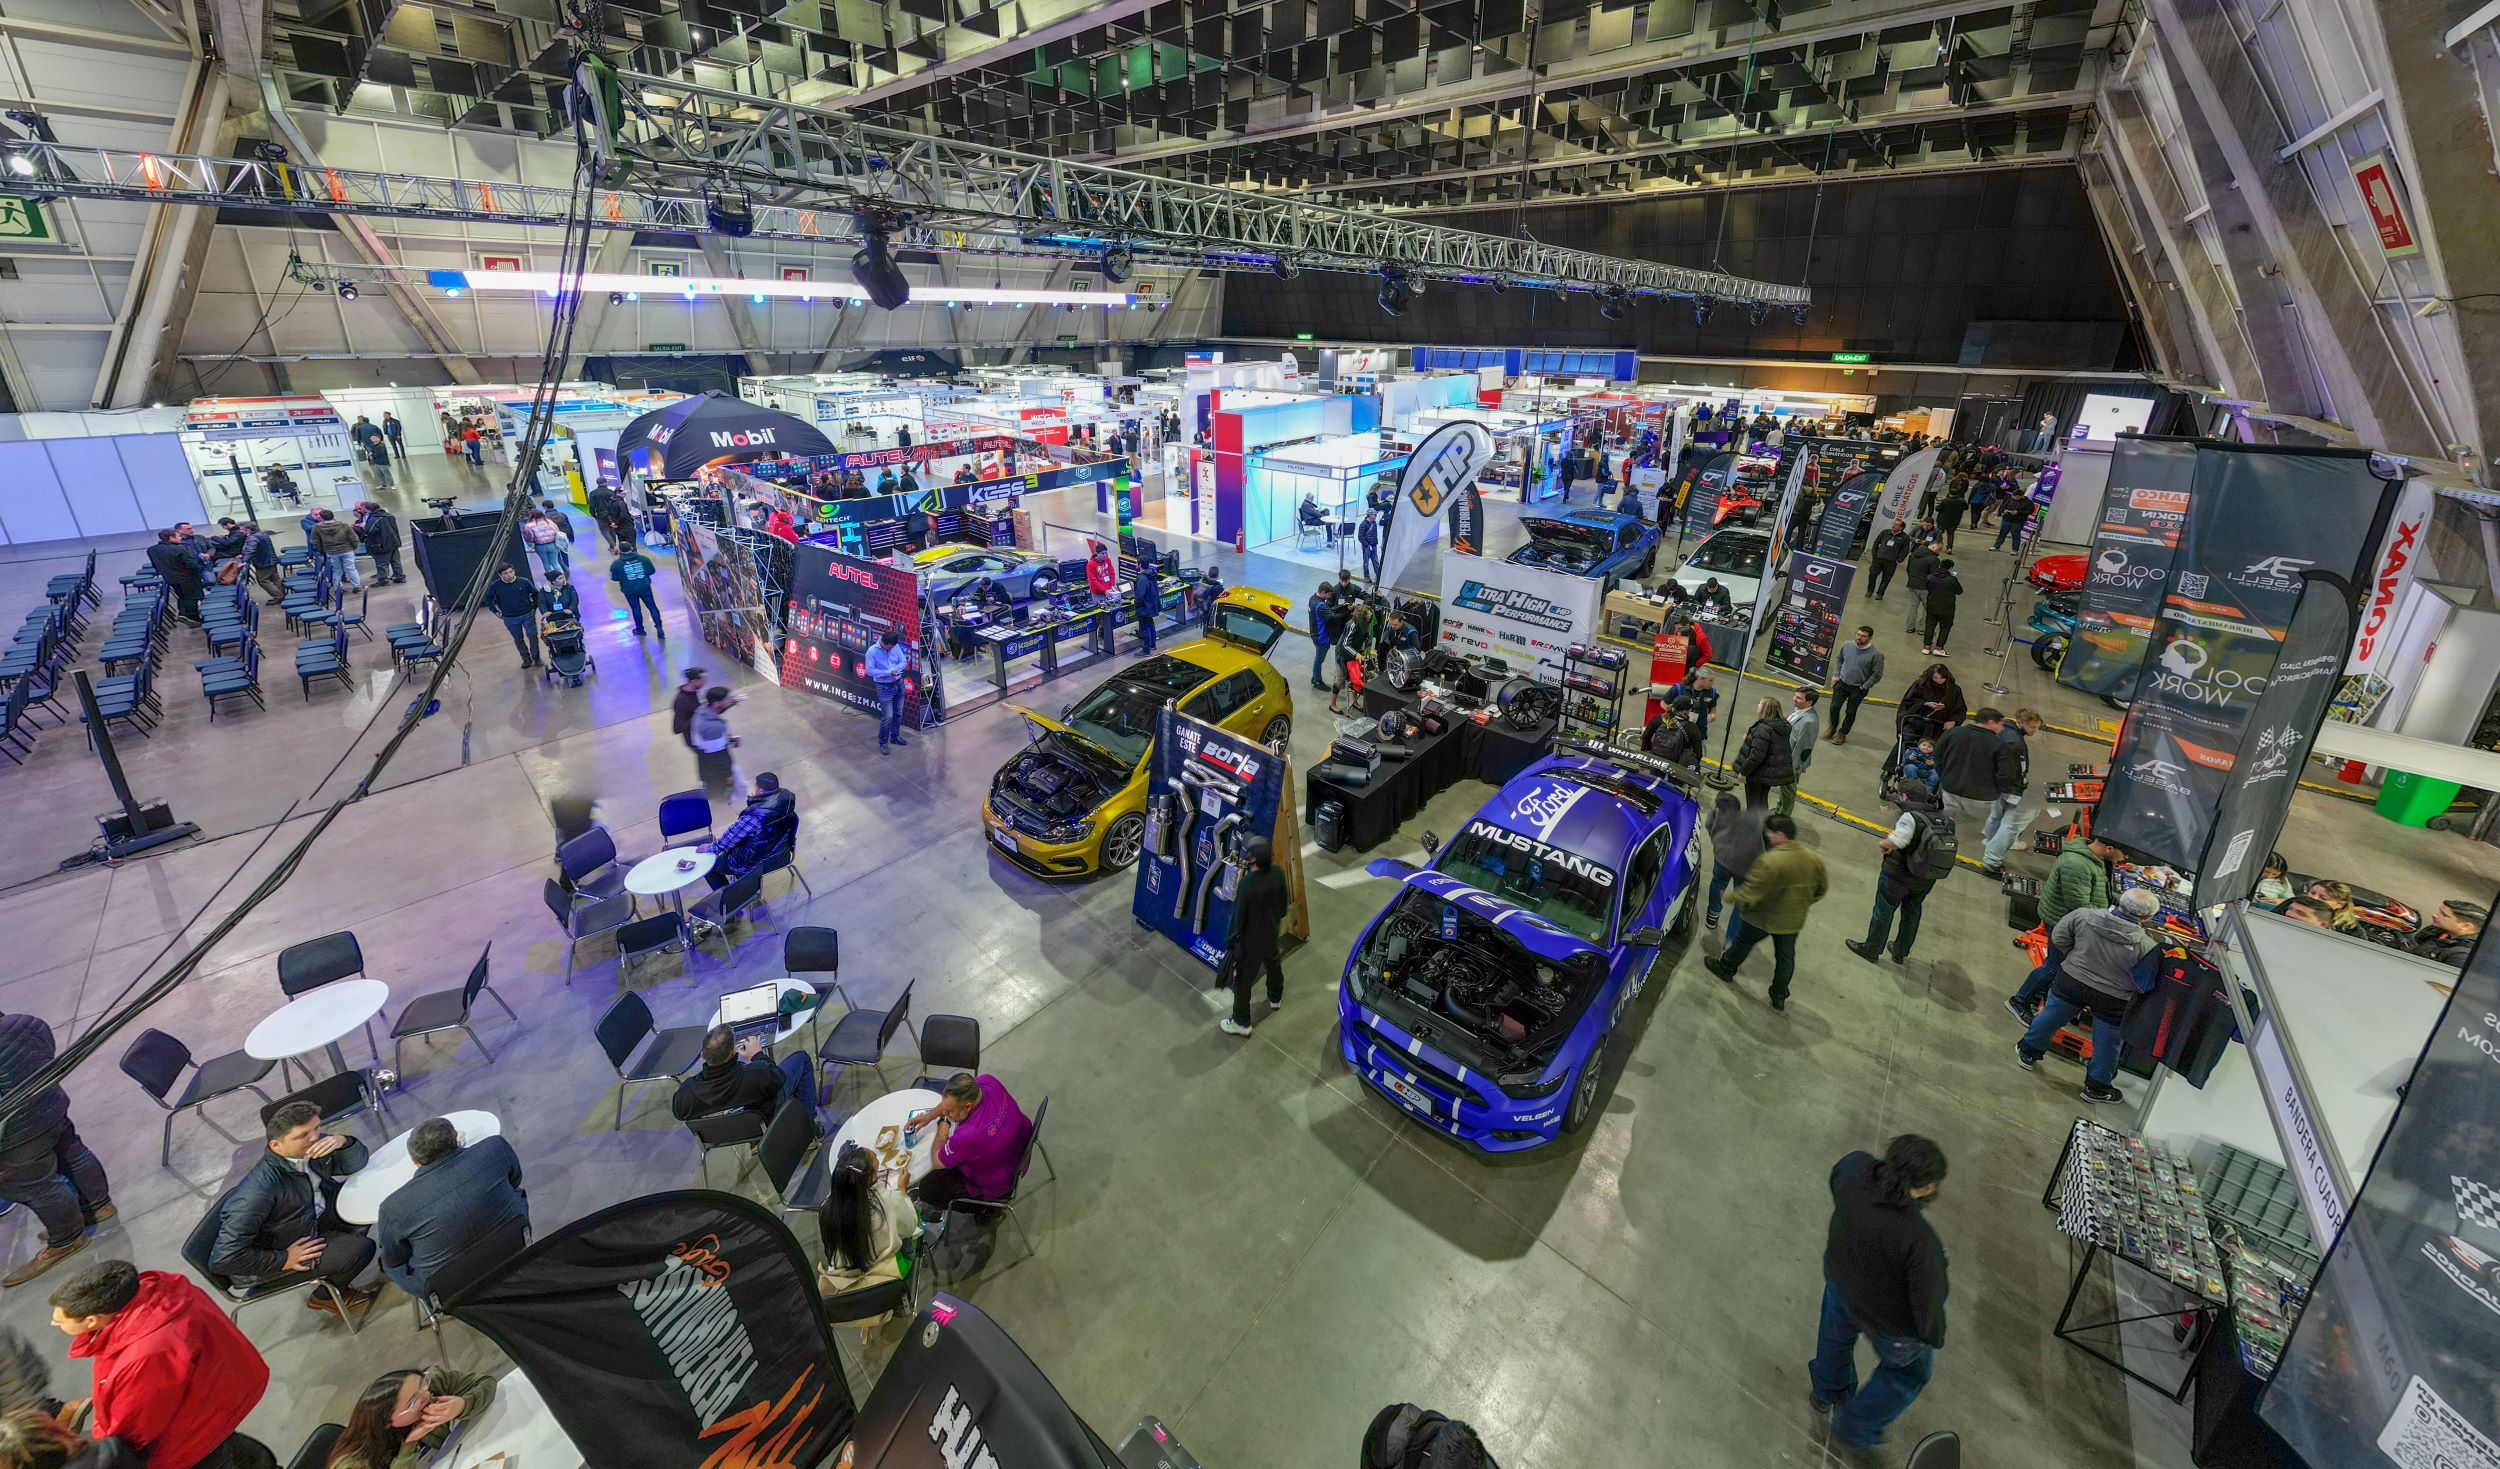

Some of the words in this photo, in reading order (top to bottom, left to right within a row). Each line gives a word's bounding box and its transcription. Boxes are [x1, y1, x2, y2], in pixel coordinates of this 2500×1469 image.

[710, 428, 775, 448] Mobil
[845, 449, 910, 467] AUTEL
[1892, 486, 1905, 507] CHILE
[829, 562, 878, 590] AUTEL
[1460, 580, 1508, 604] ULTRA
[1506, 590, 1551, 613] HIGH
[1490, 604, 1572, 633] PERFORMANCE
[1177, 725, 1201, 745] GANATE
[1180, 738, 1196, 754] ESTE
[1607, 746, 1669, 769] WHITELINE
[1517, 783, 1574, 826] Ford
[1469, 821, 1614, 887] MUSTANG
[1513, 1107, 1555, 1122] VELGEN
[2284, 1086, 2316, 1169] BANDERA
